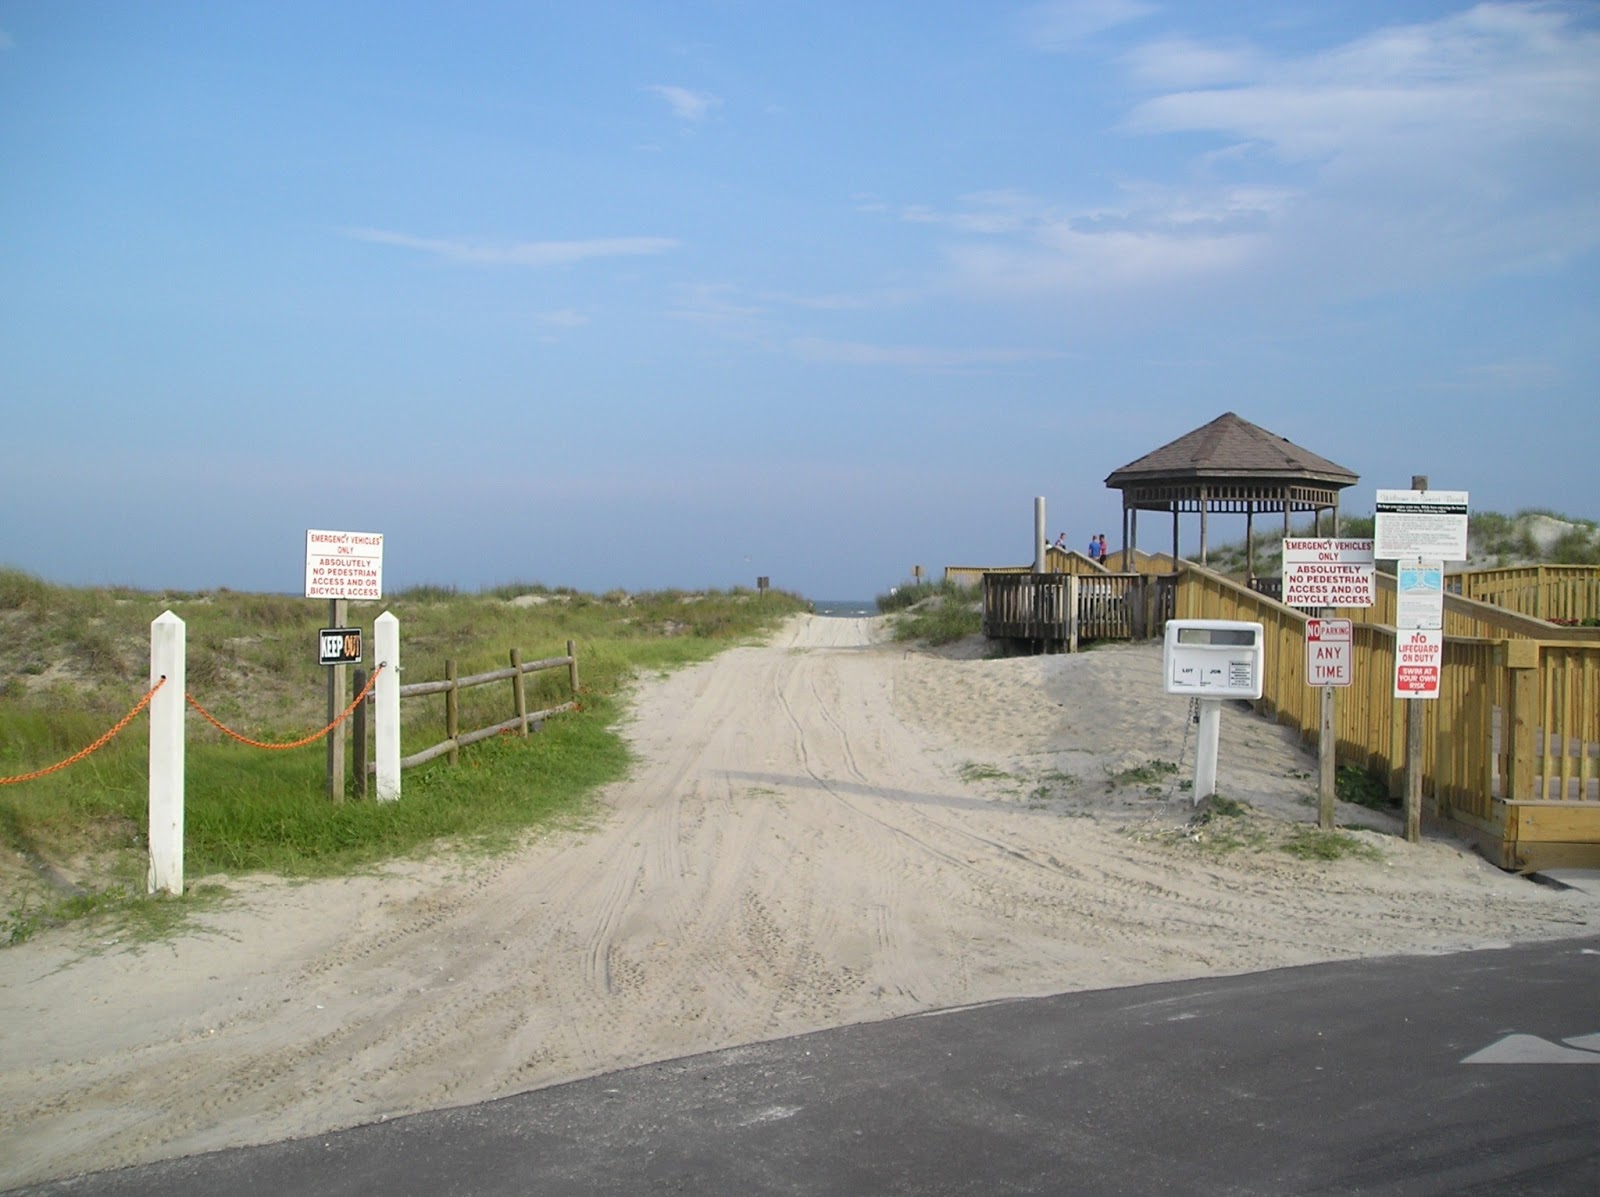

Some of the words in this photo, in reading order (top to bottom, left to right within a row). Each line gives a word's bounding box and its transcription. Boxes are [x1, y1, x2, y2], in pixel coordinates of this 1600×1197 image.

[311, 534, 349, 544] EMERGENCY
[351, 536, 380, 546] VEHICLES
[337, 546, 354, 554] ONLY
[1286, 542, 1333, 550] EMERGENCY
[1334, 542, 1372, 550] VEHICLES
[1318, 552, 1339, 561] ONLY
[319, 558, 371, 567] ABSOLUTELY
[327, 568, 377, 577] PEDESTRIAN
[1297, 565, 1361, 574] ABSOLUTELY
[312, 577, 344, 586] ACCESS
[1289, 575, 1304, 583] NO
[1306, 575, 1369, 584] PEDESTRIAN
[310, 587, 344, 595] BICYCLE
[347, 588, 379, 596] ACCESS
[1289, 585, 1328, 593] ACCESS
[1287, 595, 1329, 603] BICYCLE
[1332, 595, 1372, 604] ACCESS
[1308, 624, 1320, 637] NO
[1321, 627, 1349, 635] PARKING
[1411, 635, 1427, 644] NO
[321, 635, 344, 658] KEEP
[344, 634, 361, 657] OUT
[1398, 644, 1439, 653] LIFEGUARD
[1316, 647, 1341, 659] ANY
[1402, 654, 1413, 662] ON
[1414, 654, 1434, 662] DUTY
[1315, 665, 1343, 678] TIME
[1399, 674, 1419, 682] YOUR
[1419, 675, 1437, 683] OWN
